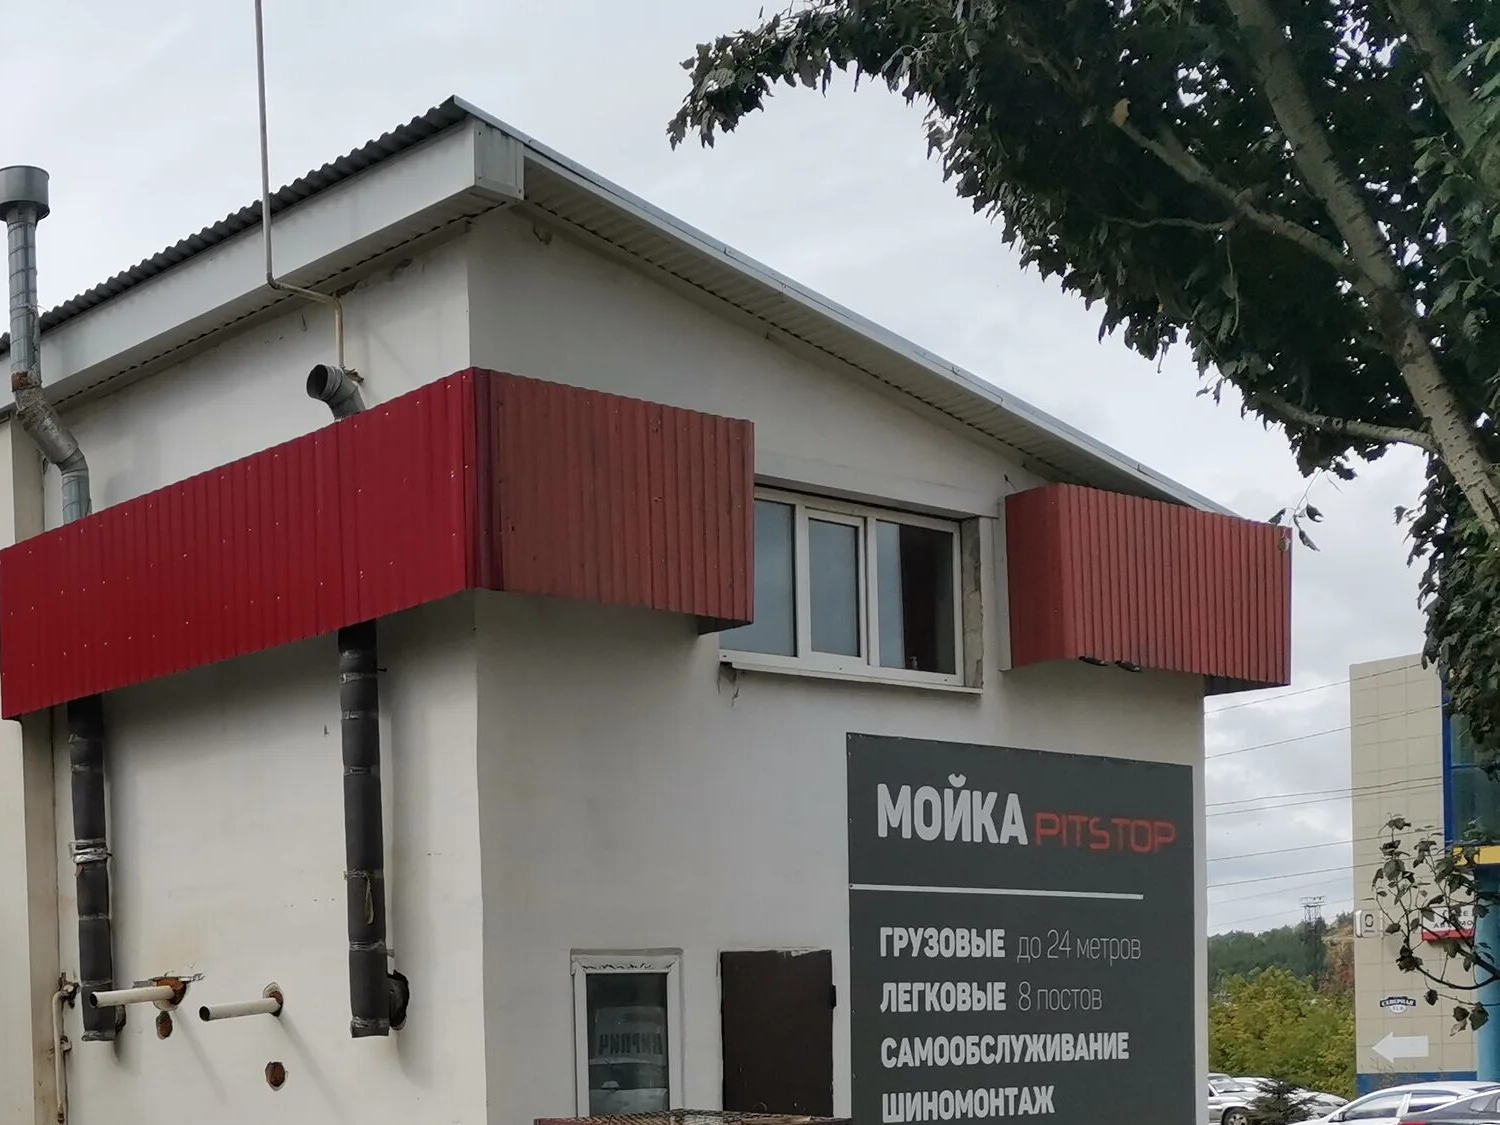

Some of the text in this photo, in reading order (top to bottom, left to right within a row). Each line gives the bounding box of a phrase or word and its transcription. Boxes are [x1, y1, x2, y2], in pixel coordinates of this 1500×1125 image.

[877, 772, 1029, 846] МОЙКА
[879, 927, 1141, 966] ГРУЗОВЫЕ до 24 метров
[880, 981, 1103, 1013] ЛЕГКОВЫЕ 8 постов
[880, 1031, 1130, 1068] САМООБСЛУЖИВАНИЕ
[882, 1086, 1056, 1123] ШИНОМОНТАЖ
